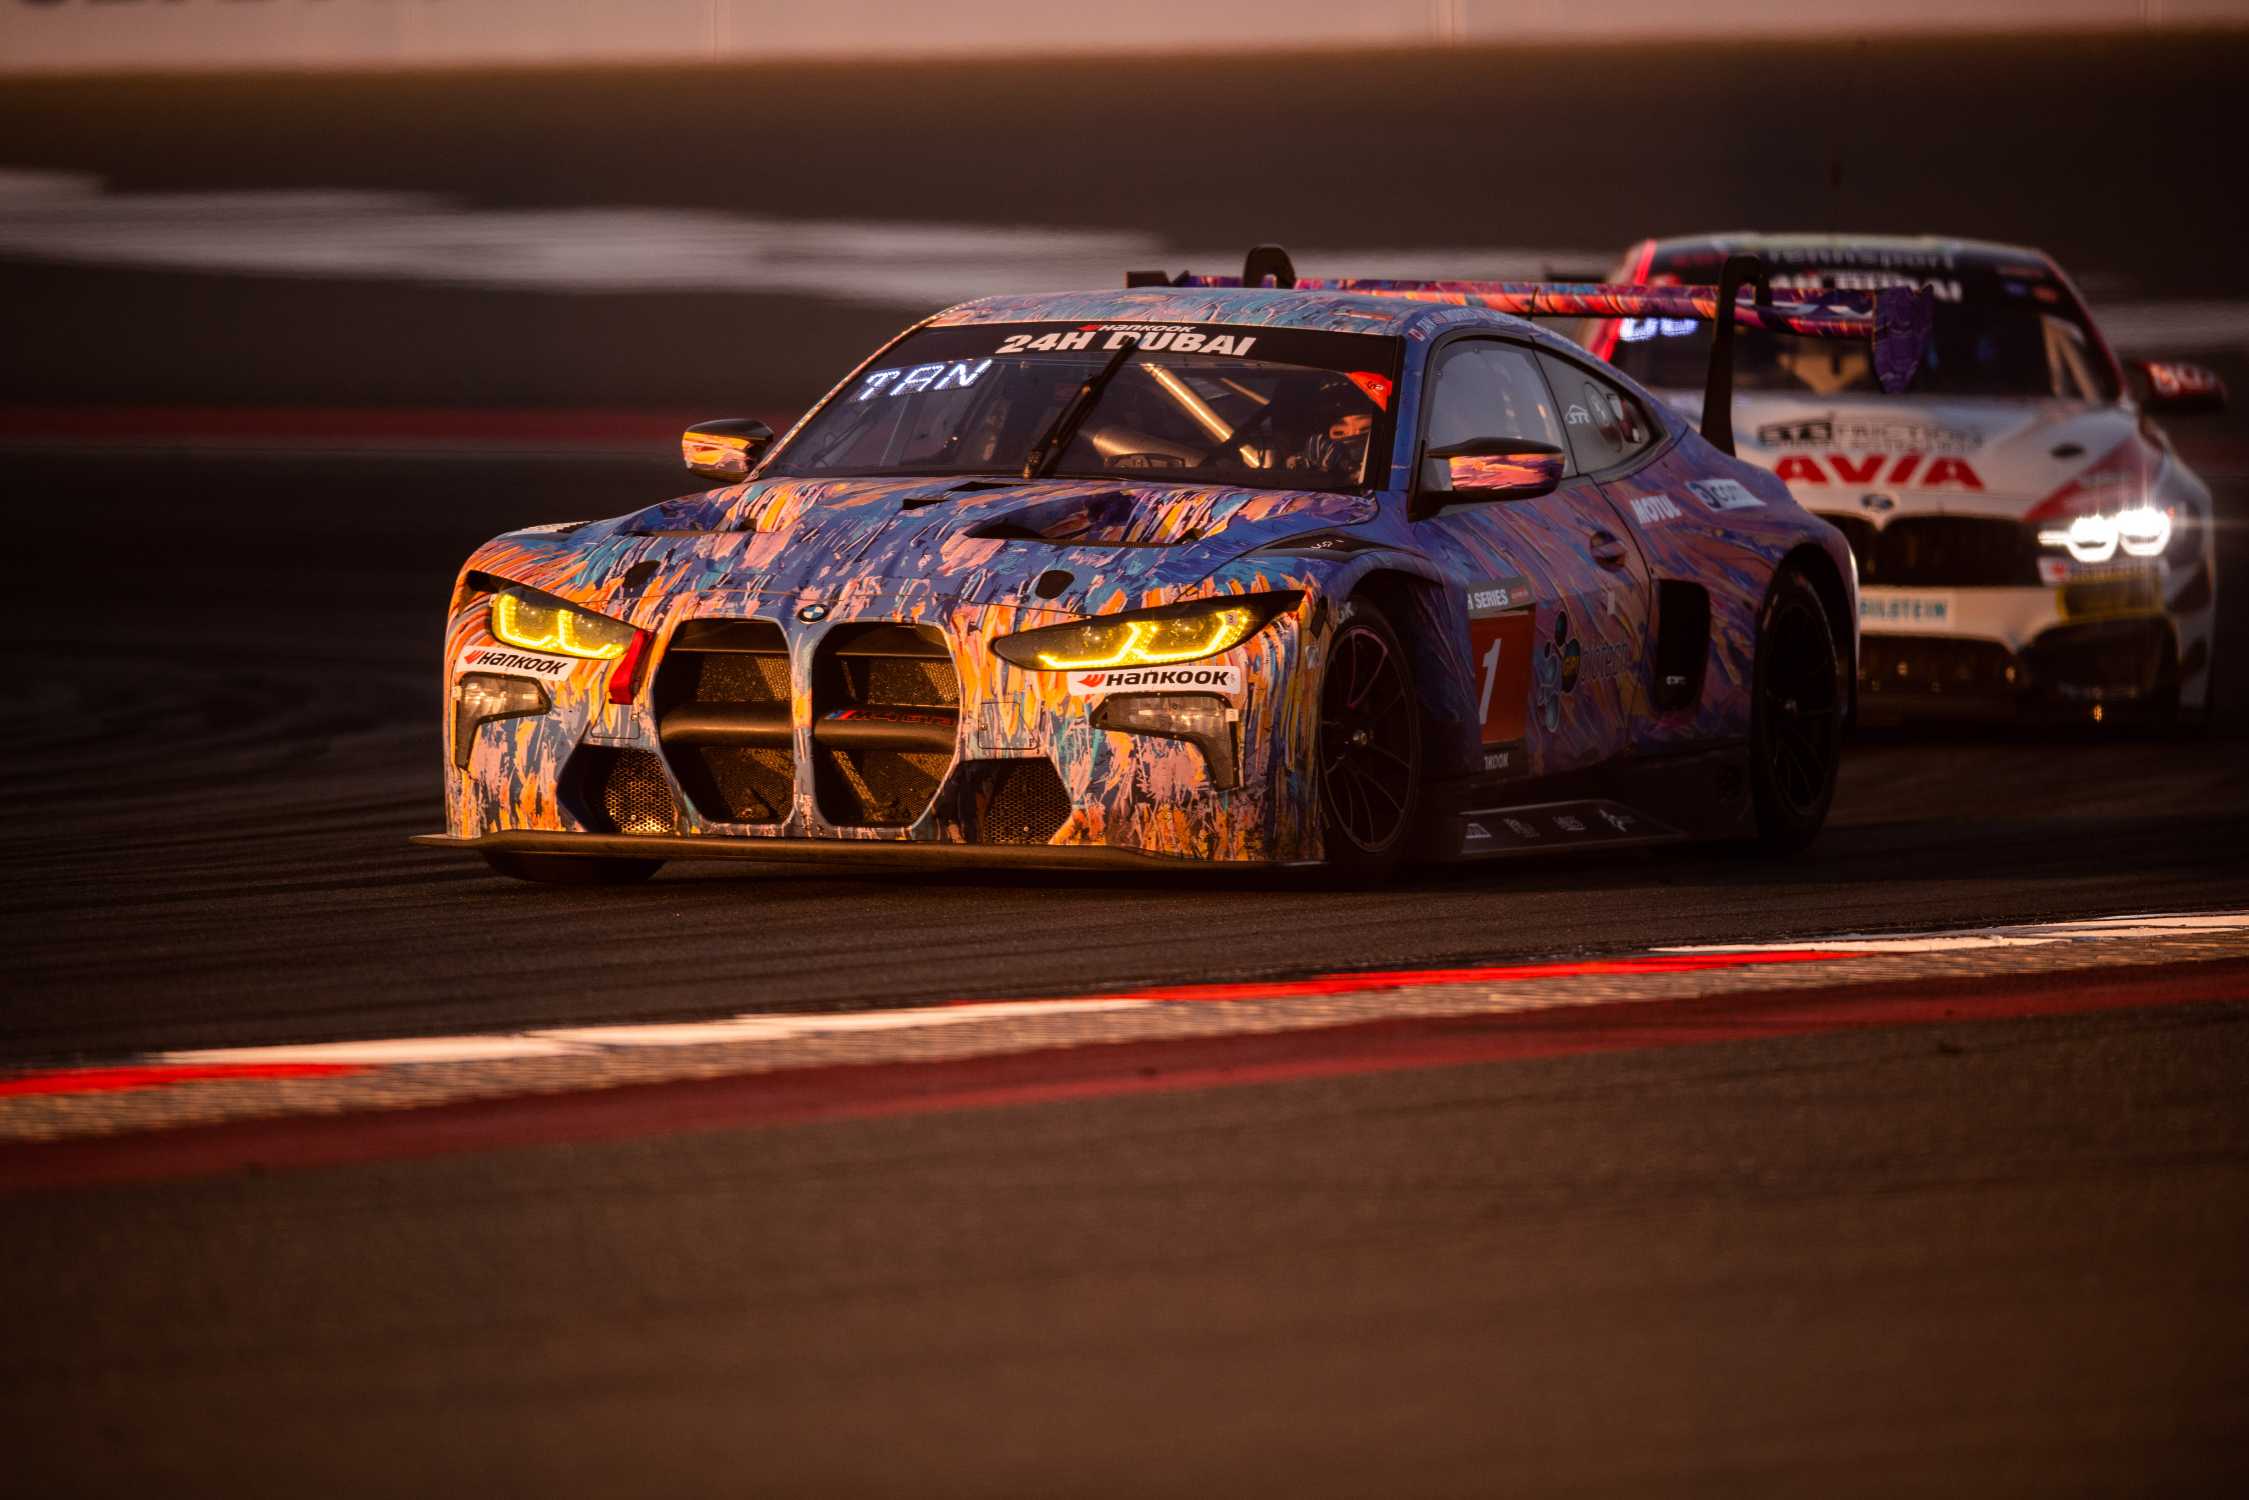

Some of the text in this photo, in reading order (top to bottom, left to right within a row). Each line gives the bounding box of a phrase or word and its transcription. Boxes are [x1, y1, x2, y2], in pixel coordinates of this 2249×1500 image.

[995, 331, 1258, 357] 24H DUBAI
[859, 359, 993, 401] TAN
[1774, 452, 1985, 487] AVIA
[1474, 588, 1509, 609] SERIES
[1478, 637, 1503, 726] 1
